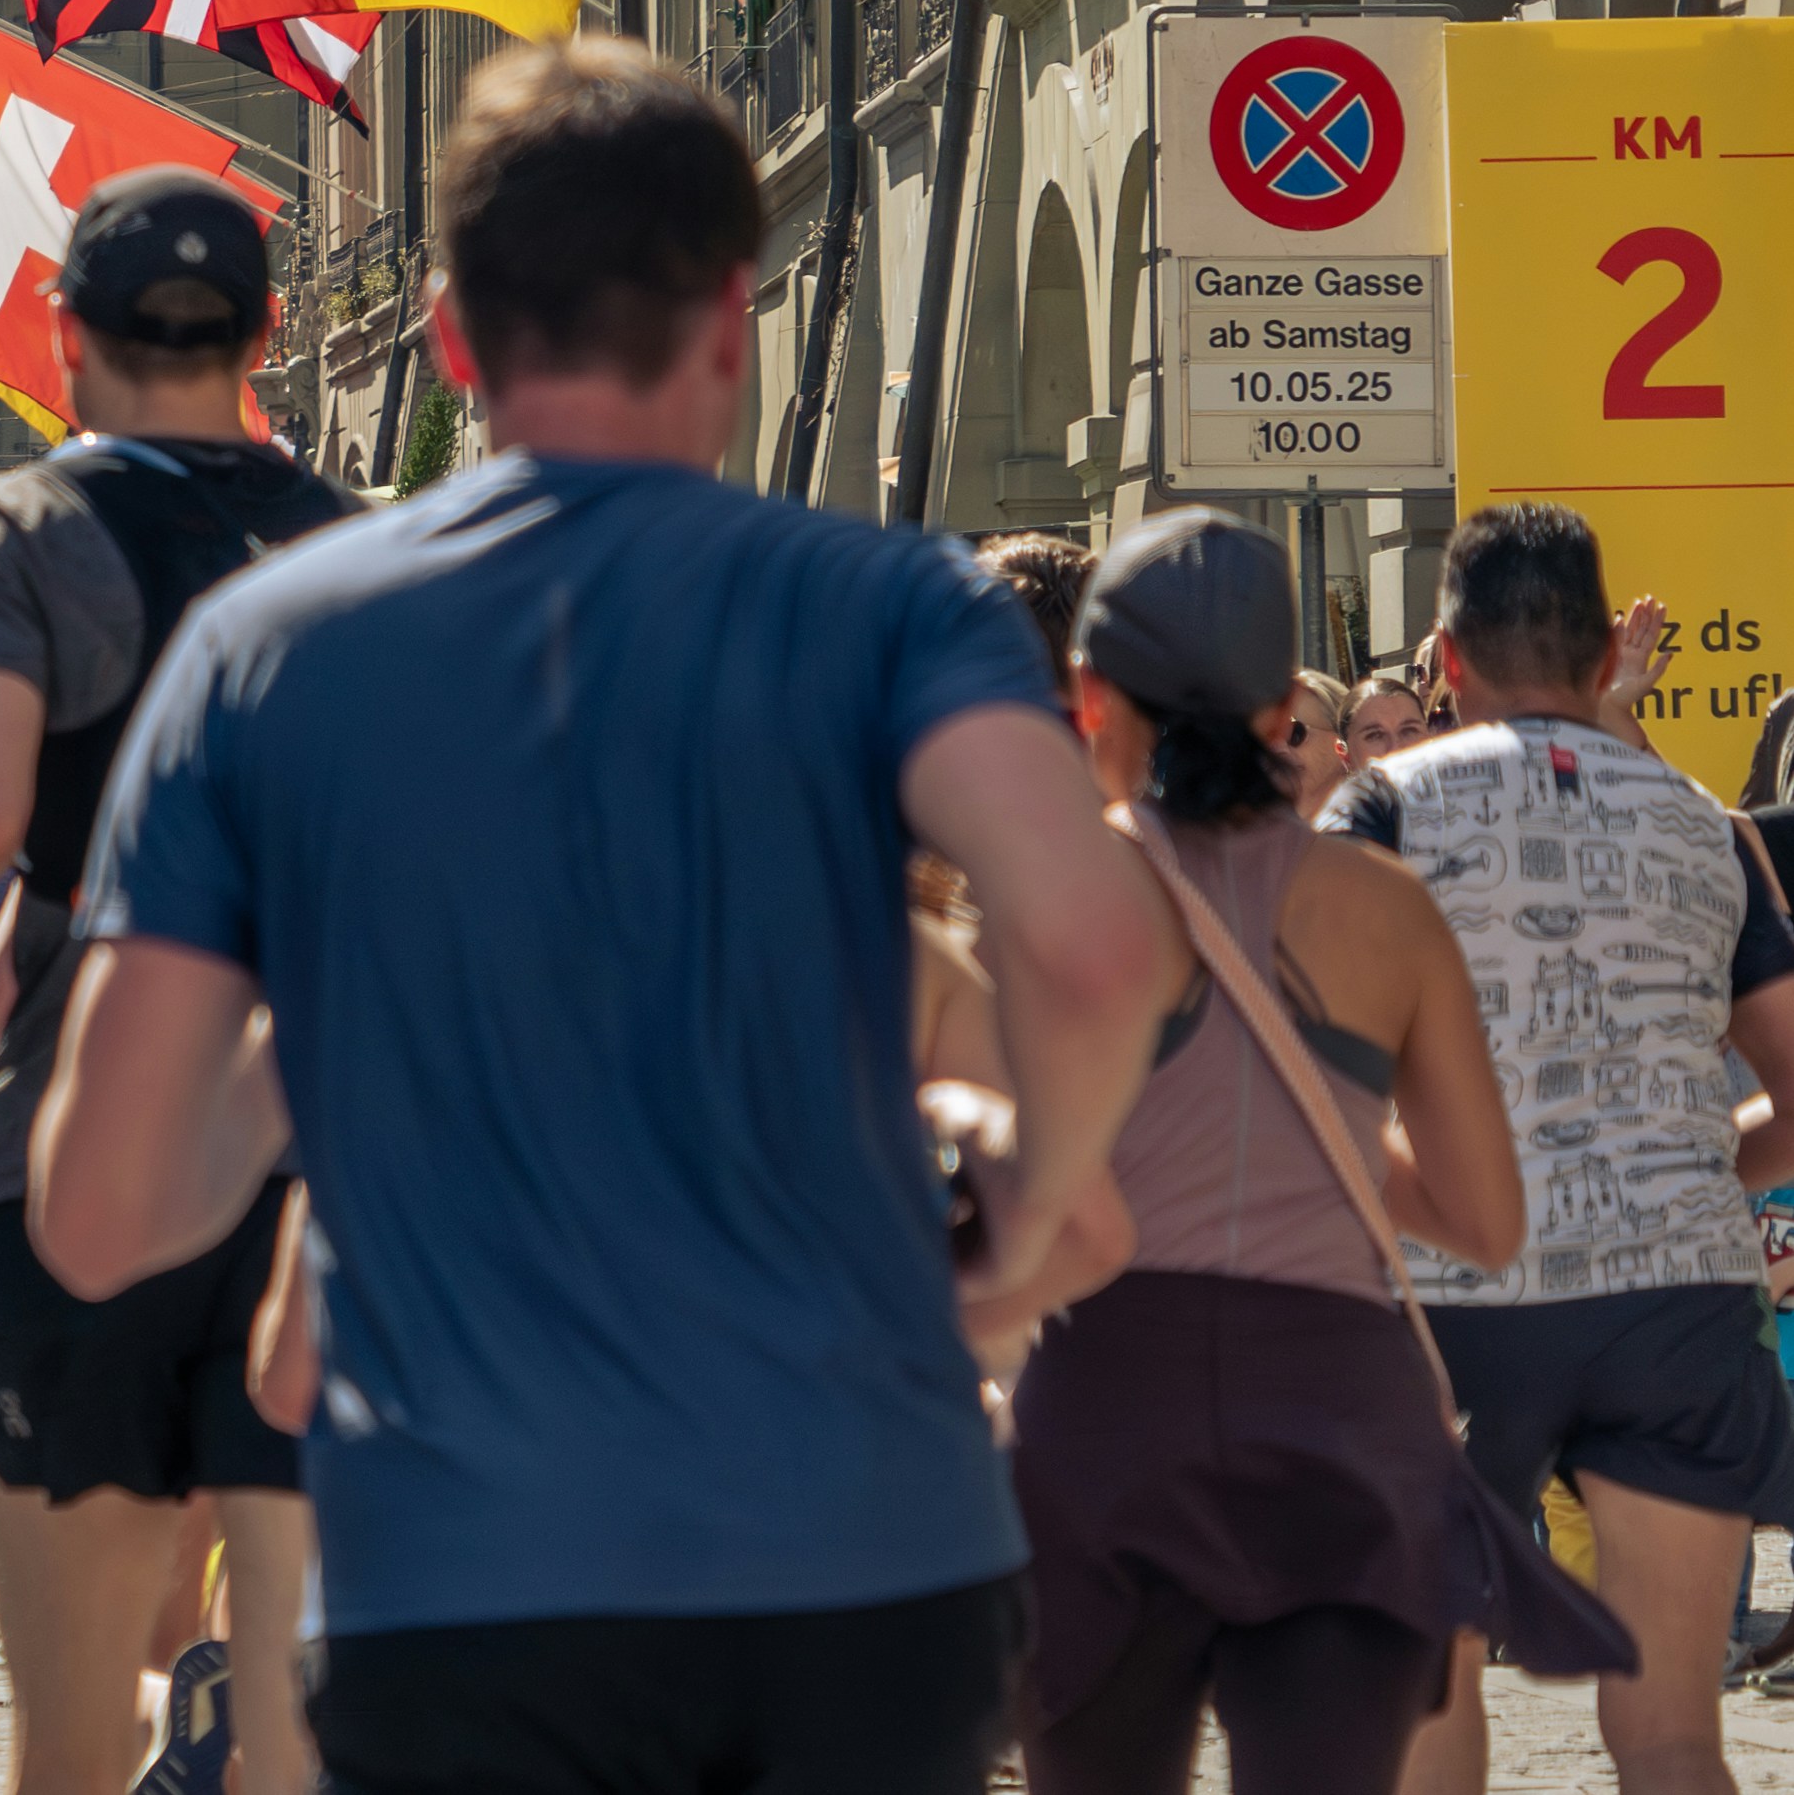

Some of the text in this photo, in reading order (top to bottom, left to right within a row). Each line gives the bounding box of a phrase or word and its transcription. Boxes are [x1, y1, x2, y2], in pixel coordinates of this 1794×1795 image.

[1613, 115, 1703, 160] KM
[1195, 266, 1424, 296] Ganze Gasse
[1208, 319, 1412, 354] ab Samstag
[1596, 226, 1726, 421] 2
[1230, 371, 1393, 402] 10.05.25
[1257, 421, 1361, 453] 10.00
[1700, 608, 1761, 652] ds
